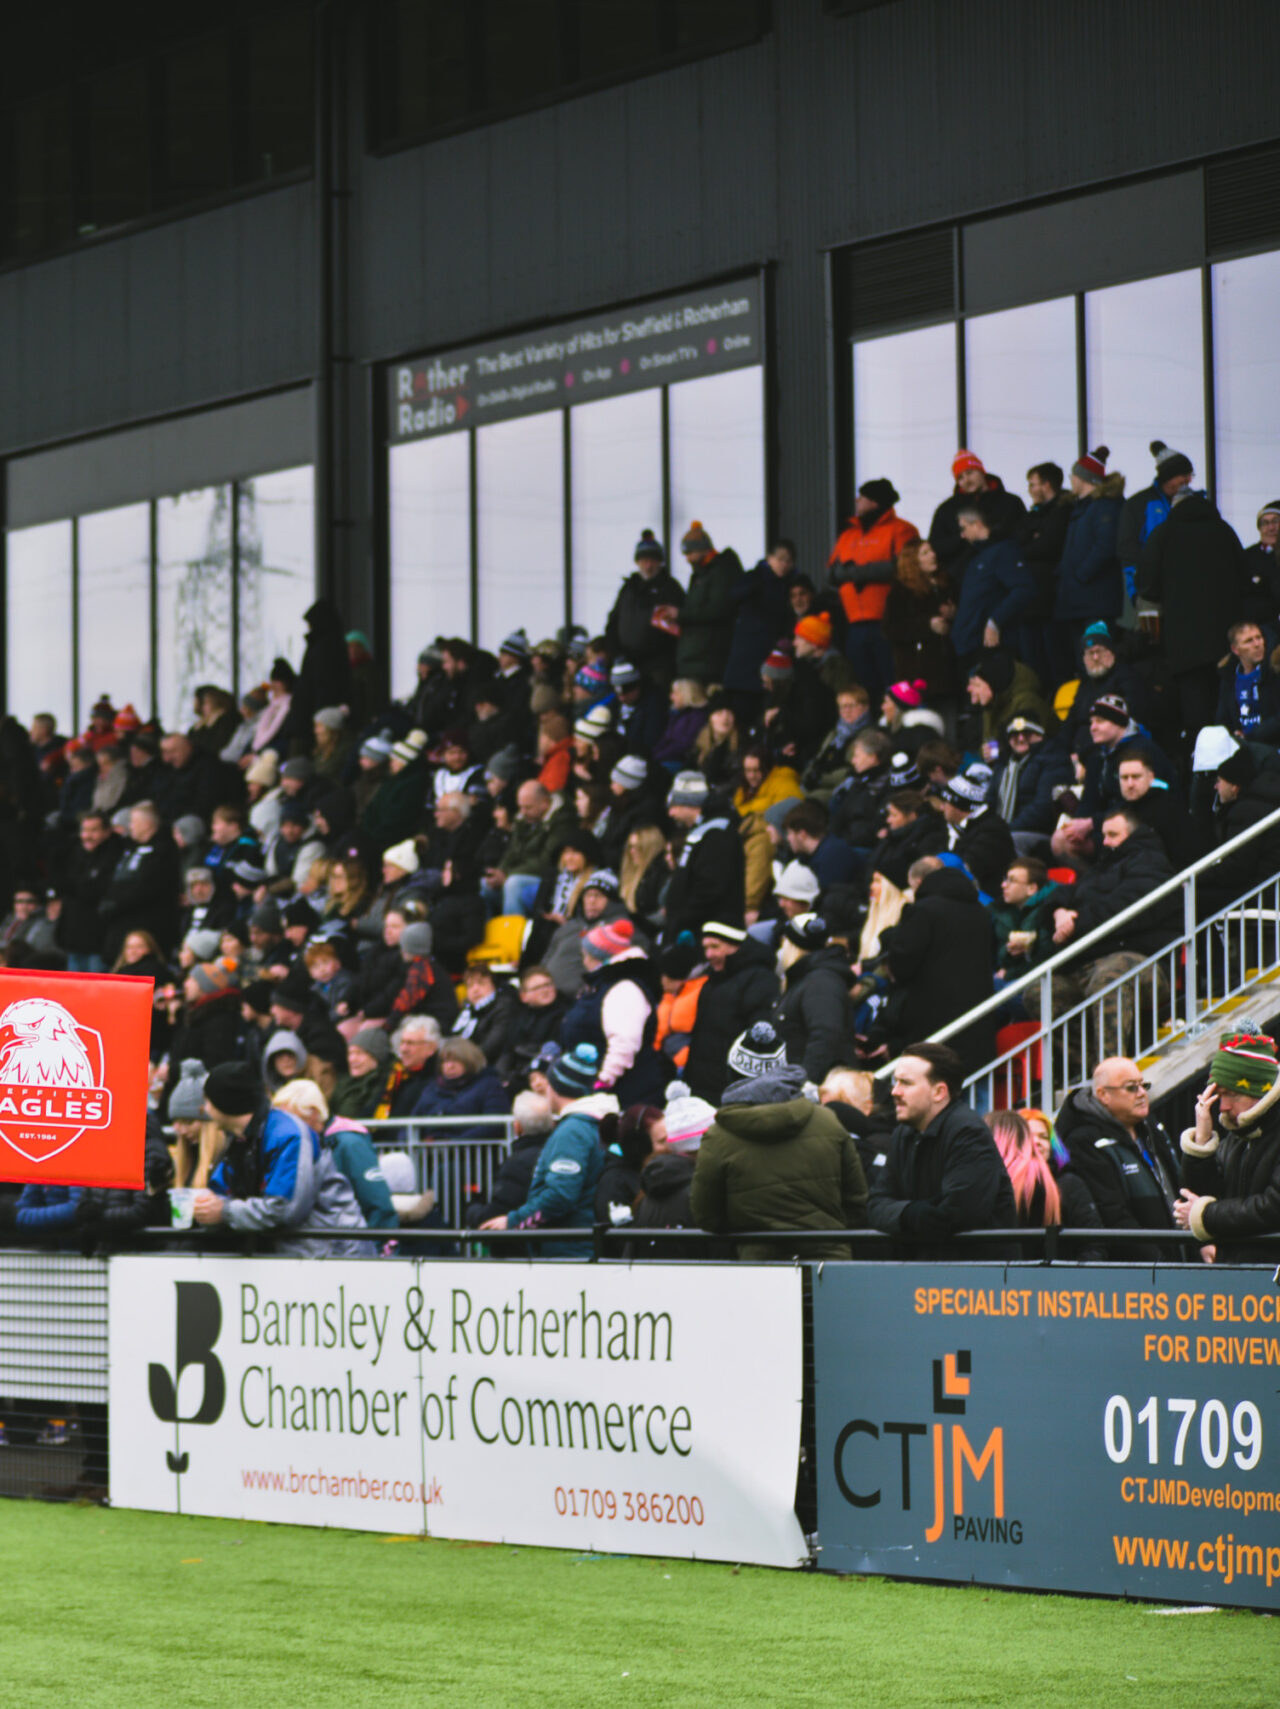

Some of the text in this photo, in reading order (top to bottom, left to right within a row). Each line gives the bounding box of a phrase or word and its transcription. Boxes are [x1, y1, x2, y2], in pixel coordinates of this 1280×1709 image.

[684, 299, 750, 327] Rotherham
[398, 397, 457, 435] Radio
[914, 1288, 1032, 1317] SPECIALIST
[1038, 1290, 1169, 1320] INSTALLERS
[1175, 1293, 1205, 1321] OF
[240, 1283, 673, 1365] Barnsley & Rotherham
[1144, 1334, 1280, 1366] FOR DRIVEW
[239, 1365, 692, 1456] Chamber of Commerce
[1104, 1395, 1262, 1470] 01709
[242, 1467, 443, 1505] www.brchamber.co.uk
[834, 1419, 1004, 1543] CTJM
[554, 1486, 704, 1526] 01709 386200
[954, 1515, 1023, 1545] PAVING
